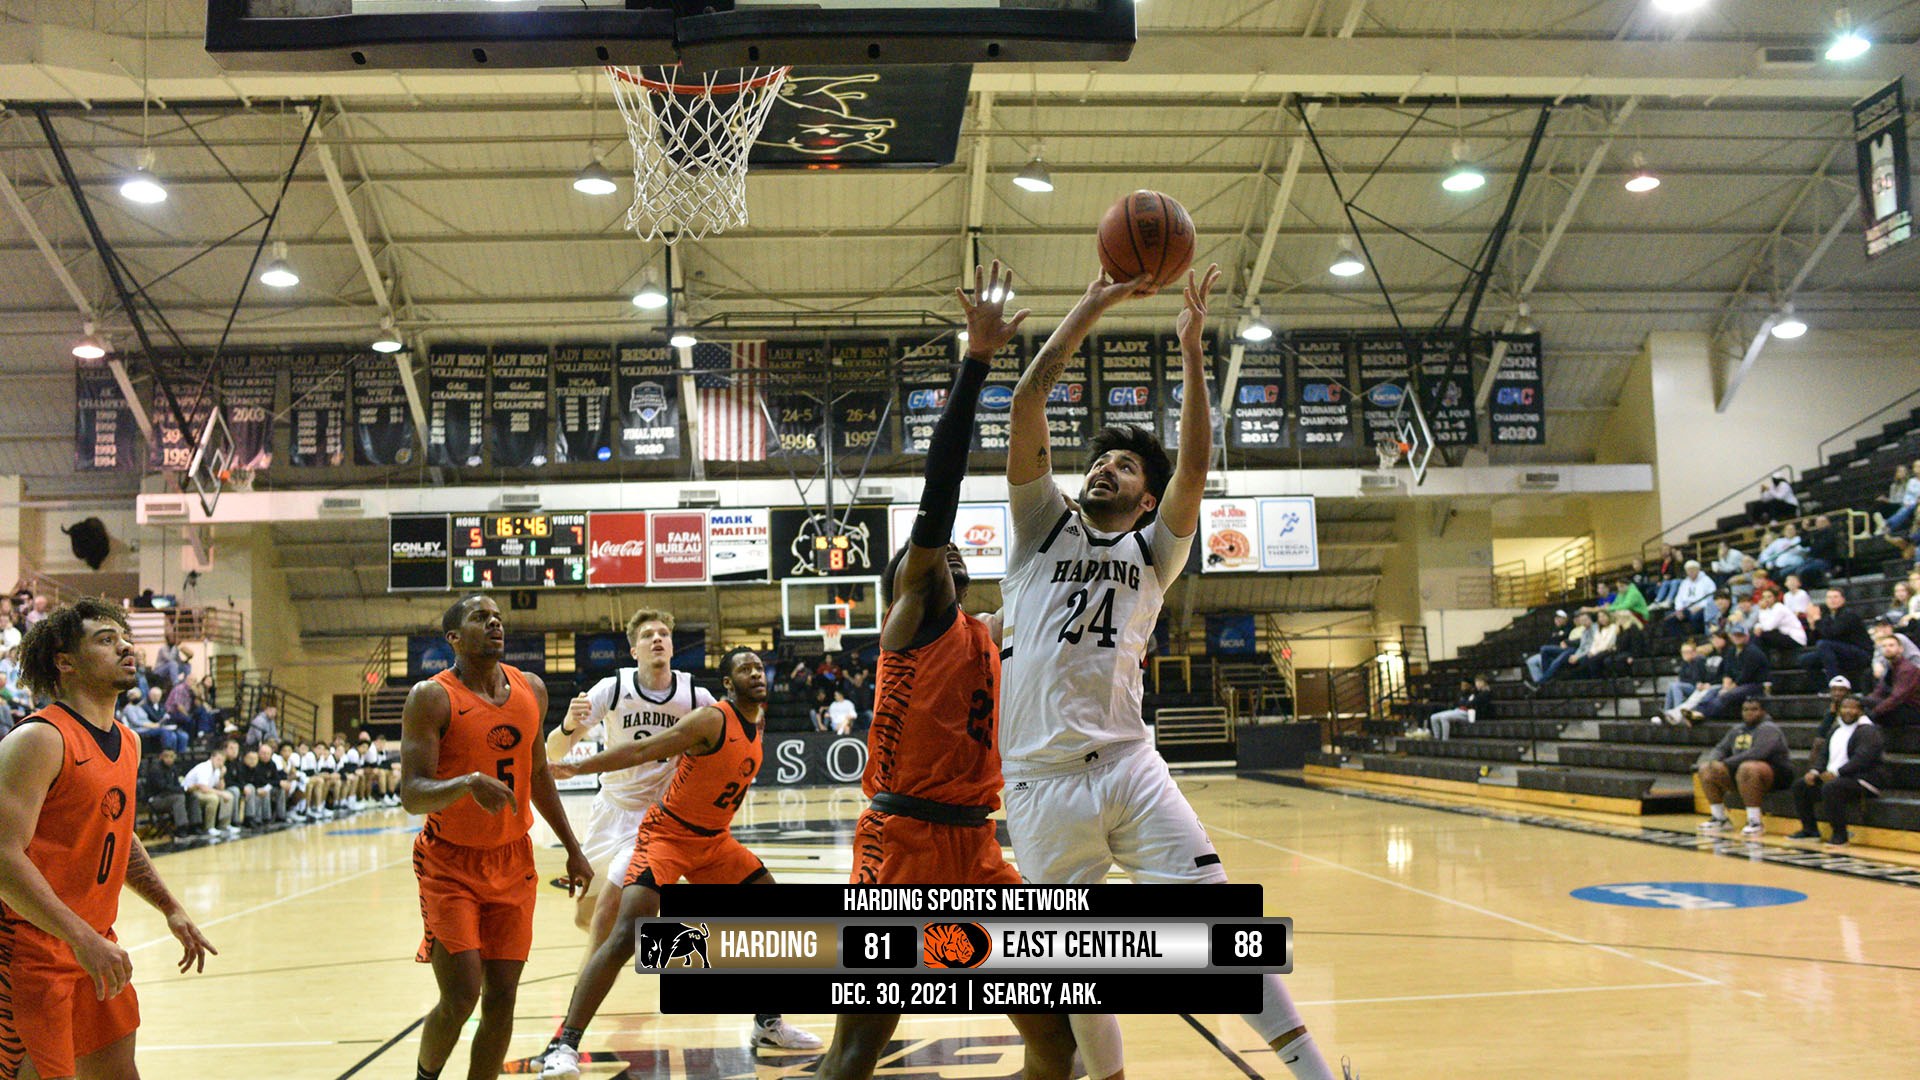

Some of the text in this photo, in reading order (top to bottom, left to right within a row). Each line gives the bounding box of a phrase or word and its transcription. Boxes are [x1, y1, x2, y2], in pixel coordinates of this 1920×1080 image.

[1104, 341, 1148, 352] LADY
[431, 355, 485, 366] LADY BISON
[493, 354, 547, 366] LADY BISON
[621, 348, 672, 361] BISON
[1104, 357, 1150, 367] BISON
[620, 366, 672, 376] VOLLEYBALL
[908, 388, 948, 409] GAC
[1109, 387, 1148, 405] GAC
[1239, 384, 1279, 404] GAC
[1303, 384, 1342, 403] GAC
[782, 409, 813, 422] 24-5
[846, 409, 877, 422] 26-4
[1235, 407, 1284, 418] CHAMPIONS
[1300, 415, 1348, 426] CHAMPIONS
[1498, 426, 1538, 440] 2020
[456, 517, 481, 527] HOME
[552, 515, 584, 525] VISITOR
[711, 515, 755, 524] MARK
[496, 517, 548, 536] 16:46
[711, 527, 767, 536] MARTIN
[469, 527, 483, 548] 5
[571, 526, 583, 545] 7
[667, 531, 702, 544] FARM
[969, 528, 993, 541] DQ
[392, 541, 441, 553] CONLEY
[530, 540, 537, 557] 1
[655, 543, 703, 555] BUREAU
[497, 558, 520, 567] PLAYER
[663, 557, 703, 565] INSURANCE
[830, 549, 844, 570] 8
[462, 565, 475, 583] 0
[483, 569, 493, 581] 4
[545, 568, 556, 580] 4
[571, 564, 584, 581] 2
[1058, 588, 1117, 648] 24
[421, 658, 448, 672] NCAA
[497, 758, 514, 797] 5
[713, 782, 749, 812] 24
[97, 832, 115, 885] 0
